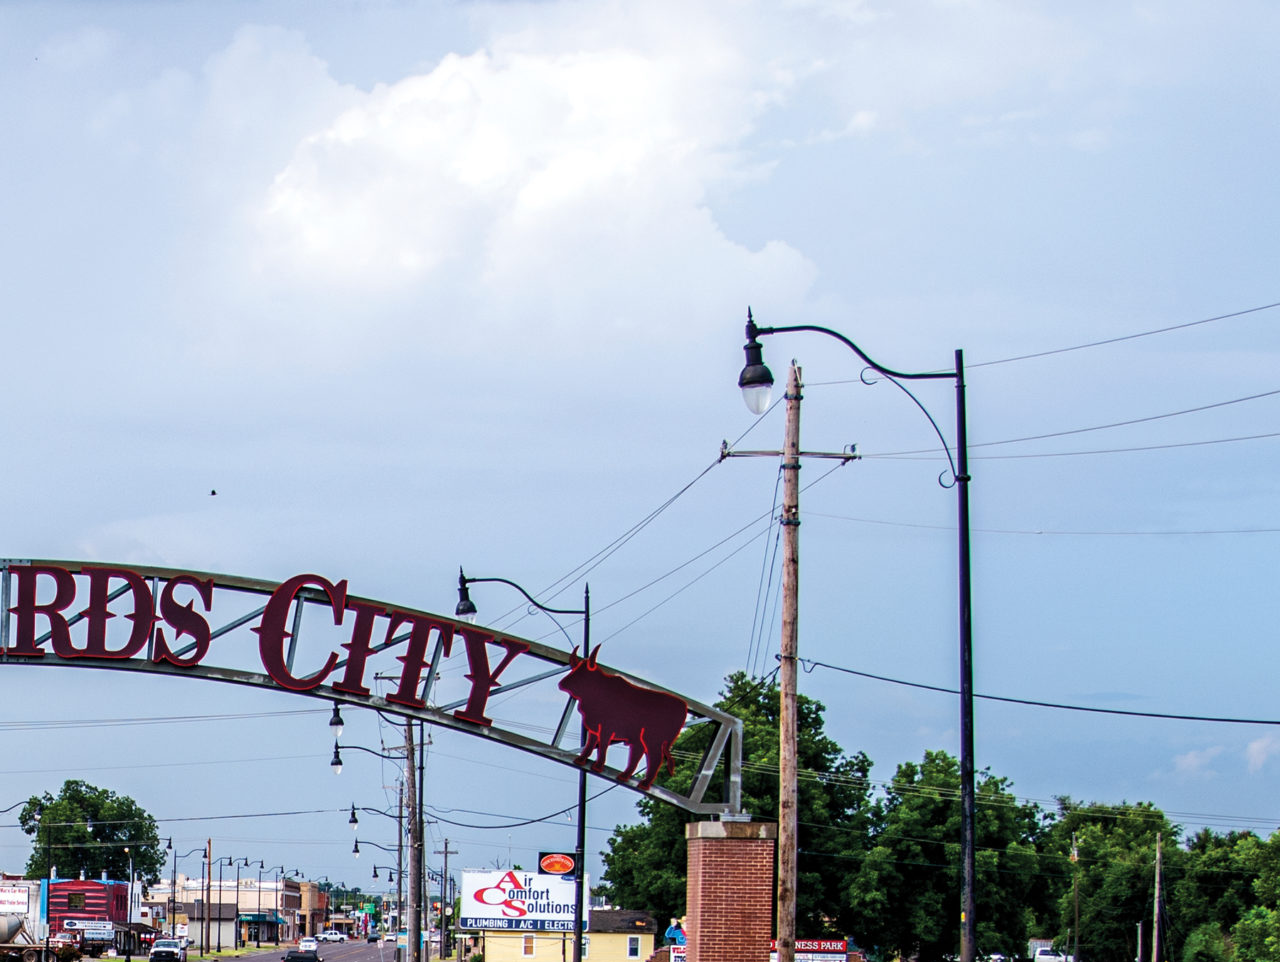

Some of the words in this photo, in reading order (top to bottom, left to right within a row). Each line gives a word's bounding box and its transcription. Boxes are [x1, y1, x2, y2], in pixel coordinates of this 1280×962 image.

[250, 573, 531, 727] CITY
[494, 870, 533, 889] Air
[473, 887, 550, 906] Comfort
[502, 899, 577, 918] Solutions
[467, 918, 508, 929] PLUMBING
[520, 920, 534, 929] A/C
[544, 920, 575, 930] ELECTR
[820, 942, 843, 950] PARK
